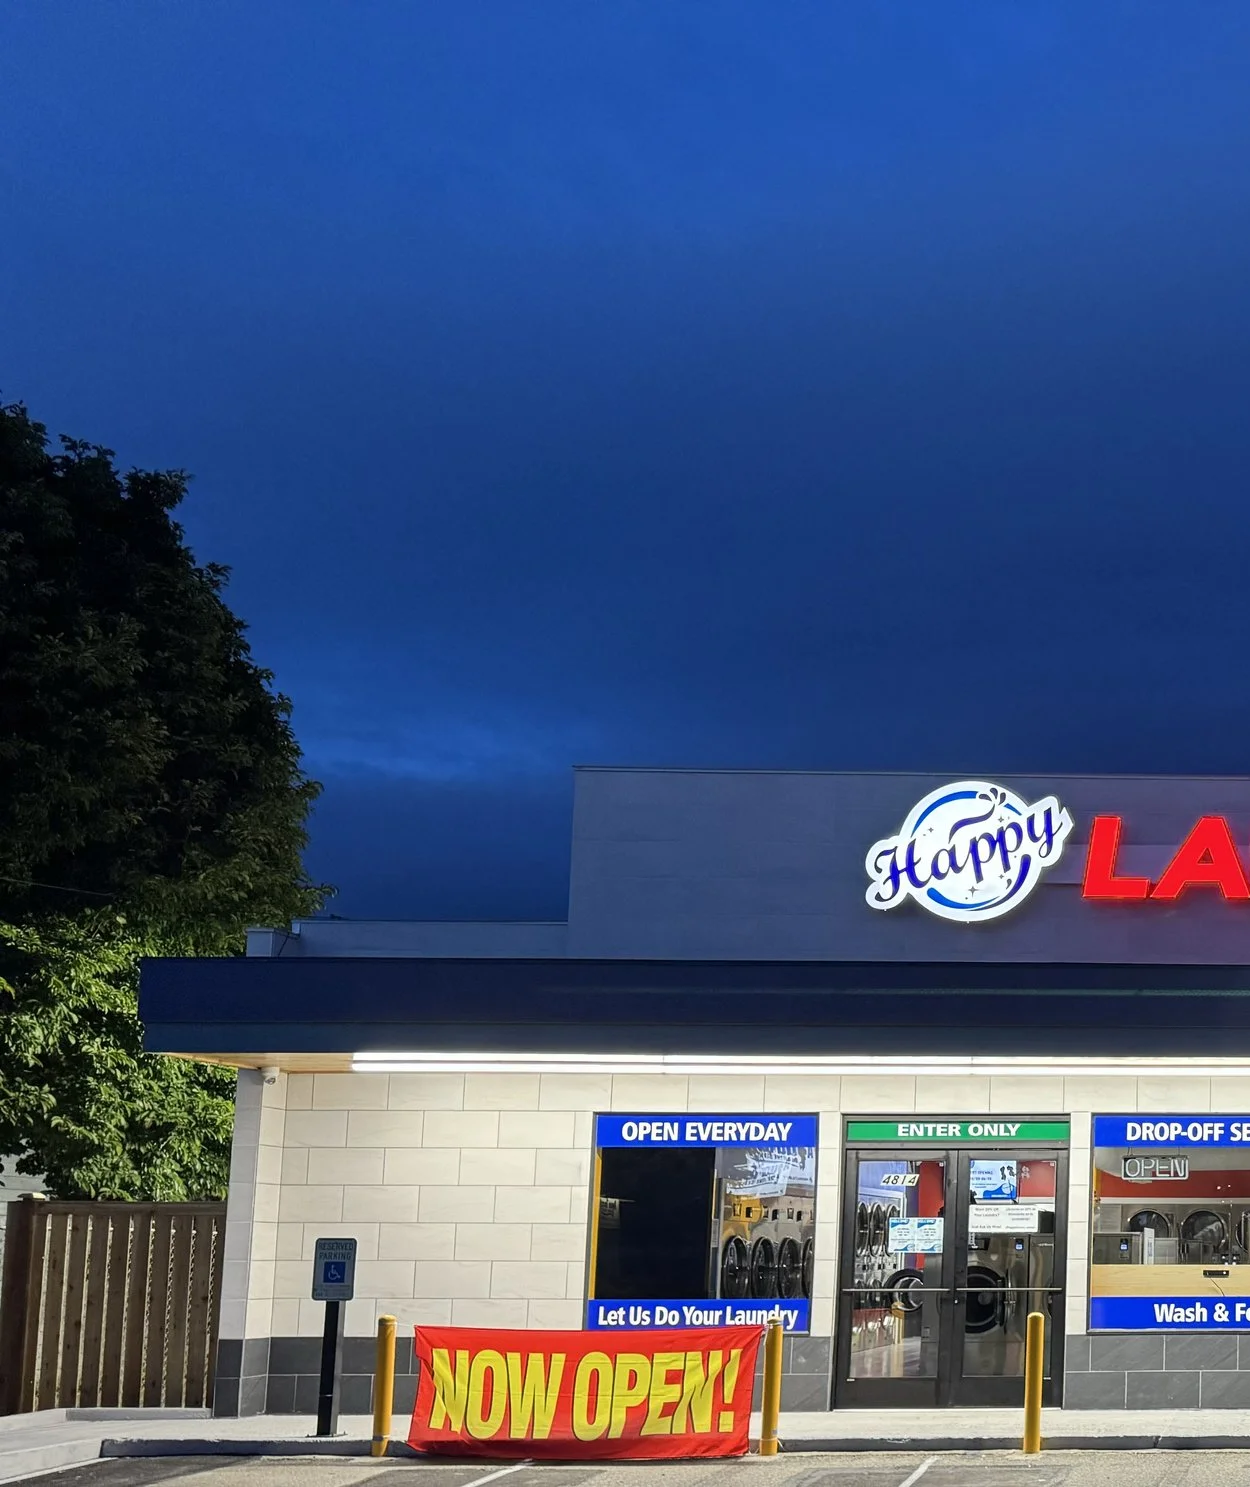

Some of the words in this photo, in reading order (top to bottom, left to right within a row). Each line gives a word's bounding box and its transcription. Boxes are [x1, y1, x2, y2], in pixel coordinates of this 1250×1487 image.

[874, 806, 1063, 901] Happy
[621, 1121, 679, 1141] OPEN
[685, 1121, 793, 1142] EVERYDAY
[897, 1122, 962, 1137] ENTER
[967, 1122, 1022, 1137] ONLY
[1126, 1122, 1225, 1142] DROP-OFF
[1125, 1158, 1185, 1177] OPEN
[882, 1174, 917, 1185] 4814
[319, 1241, 354, 1251] RESERVED
[319, 1251, 352, 1261] PARKING
[598, 1306, 626, 1326] Let
[629, 1306, 651, 1326] Us
[654, 1306, 680, 1326] Do
[682, 1306, 723, 1326] Your
[725, 1304, 799, 1330] Laundry
[1153, 1301, 1208, 1323] Wash
[1213, 1302, 1230, 1323] &
[429, 1348, 566, 1440] NOW
[573, 1348, 743, 1441] OPEN!
